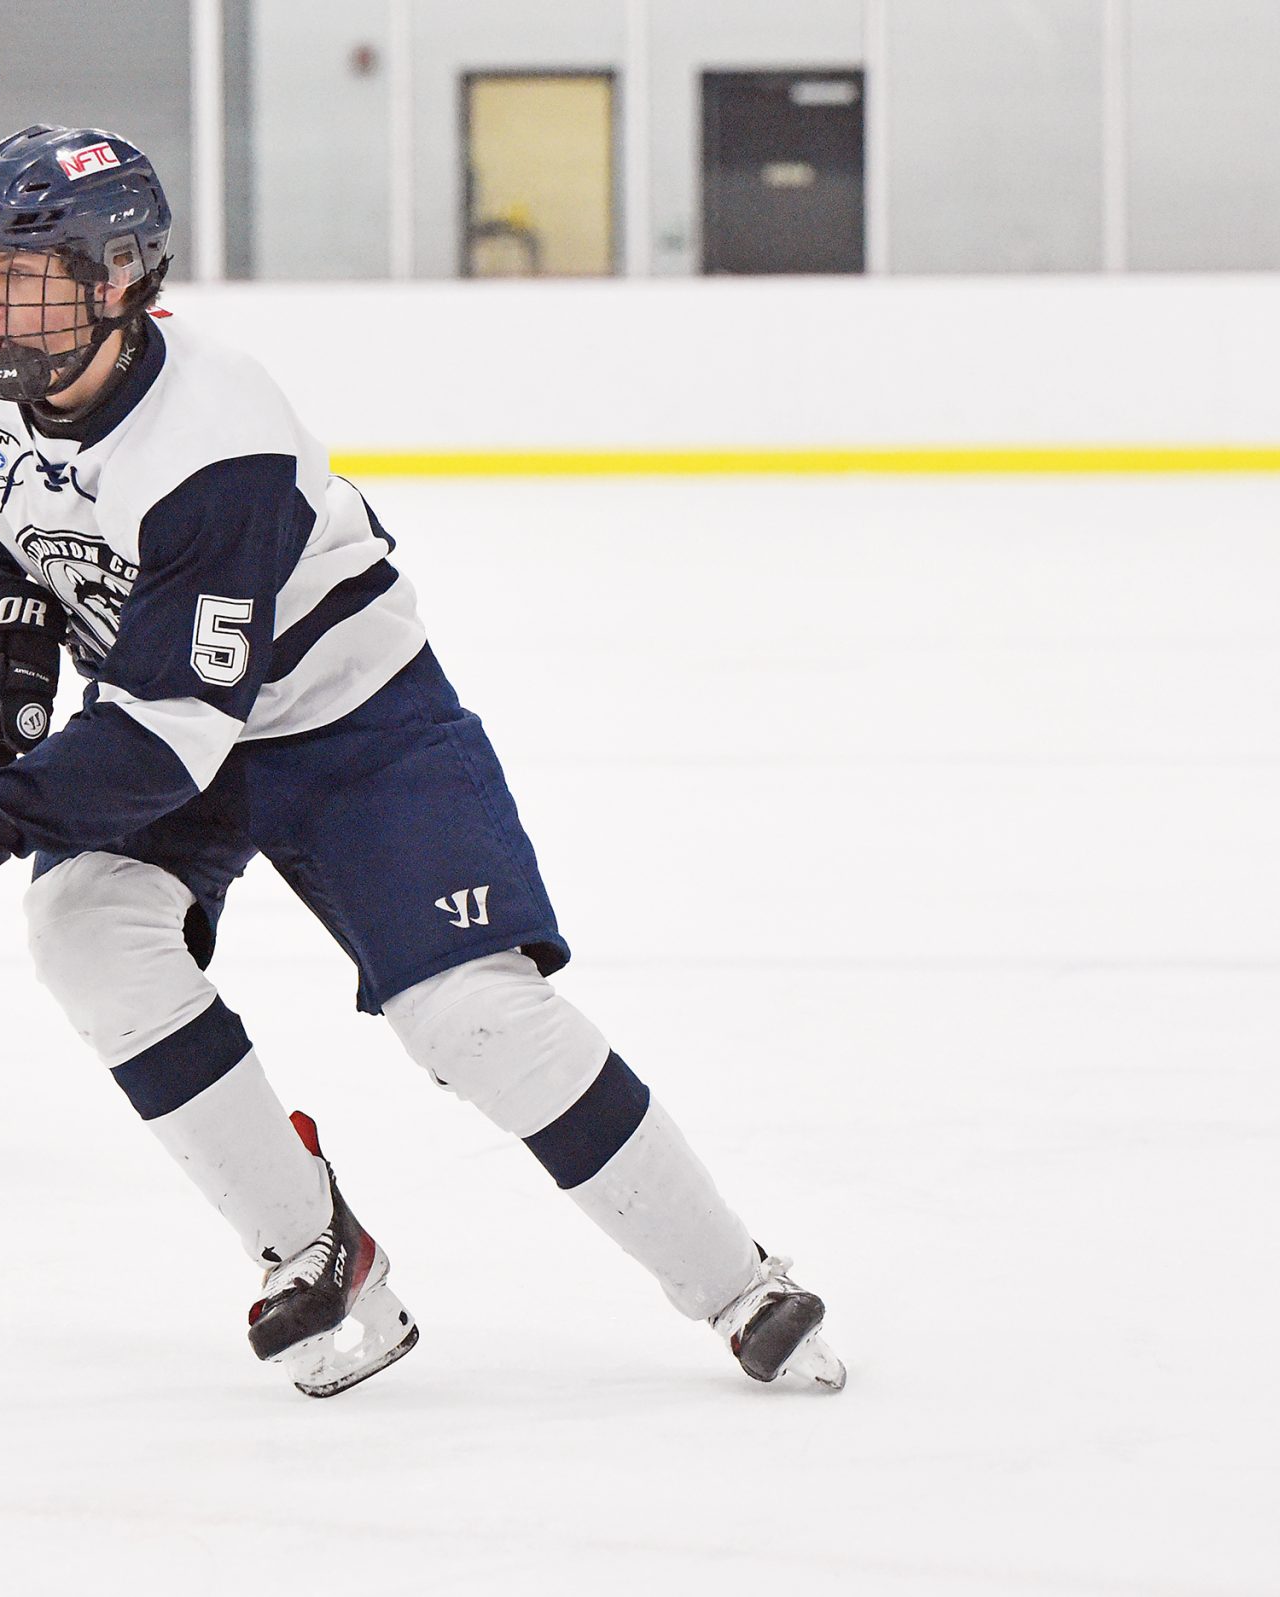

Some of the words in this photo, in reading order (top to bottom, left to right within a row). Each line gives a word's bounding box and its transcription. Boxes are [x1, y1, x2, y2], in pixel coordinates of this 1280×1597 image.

[59, 145, 118, 177] NFTC
[190, 594, 253, 687] 5
[333, 1244, 348, 1288] CCM
